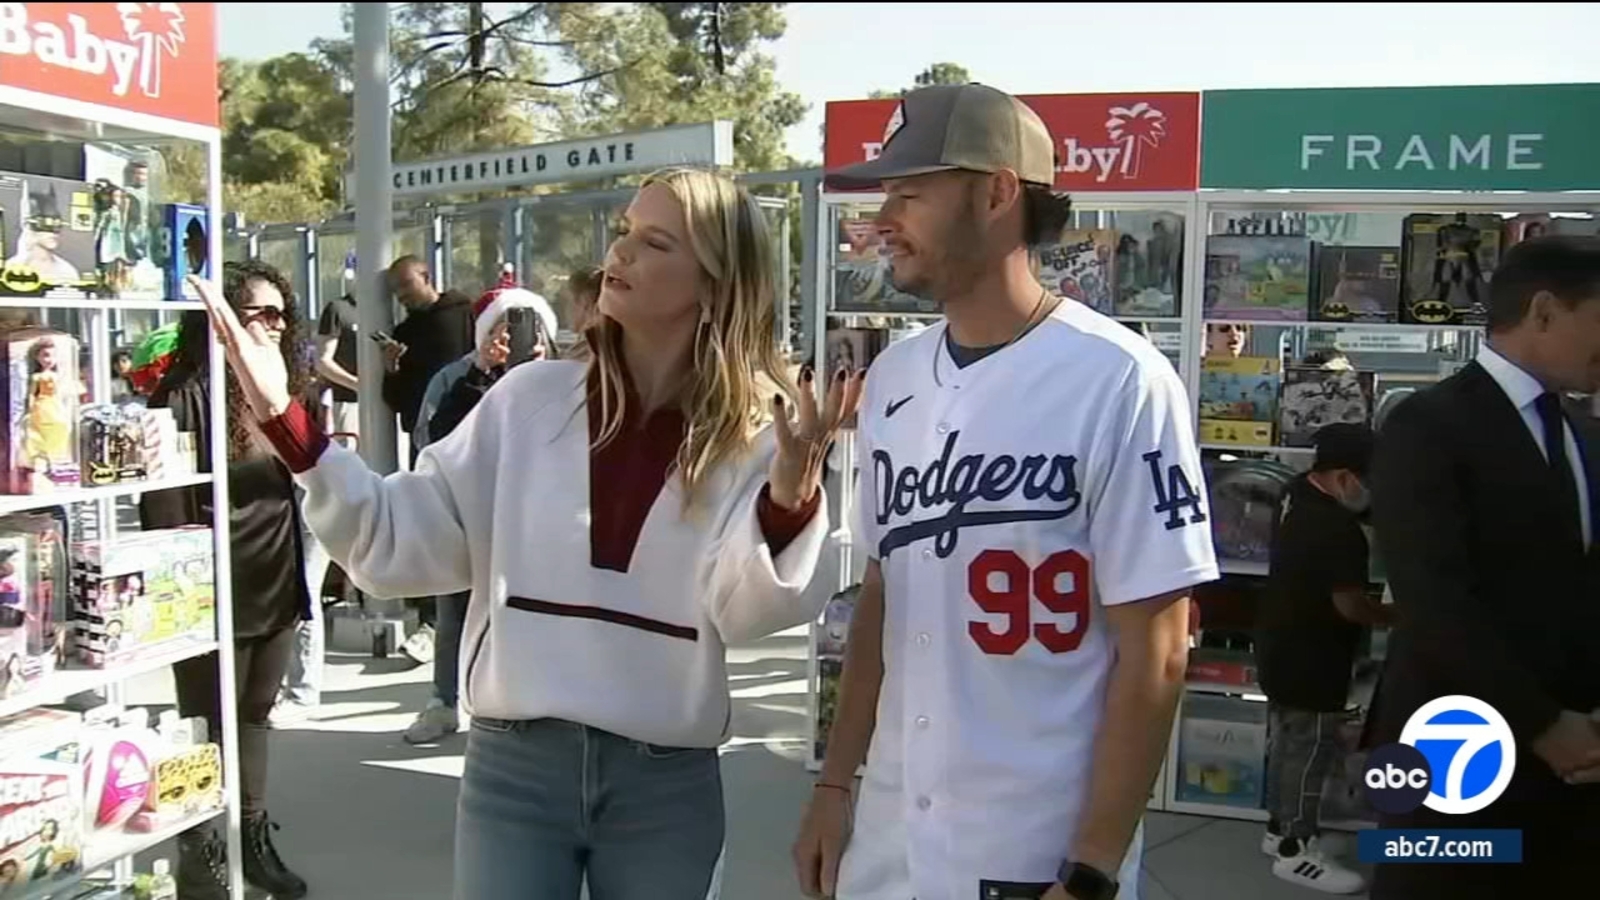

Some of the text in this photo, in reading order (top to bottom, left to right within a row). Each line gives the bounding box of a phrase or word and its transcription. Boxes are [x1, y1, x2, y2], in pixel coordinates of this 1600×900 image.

[393, 143, 635, 189] CENTERFIELD GATE
[1301, 133, 1544, 170] FRAME
[873, 430, 1081, 558] Dodgers
[1143, 450, 1206, 531] LA
[968, 549, 1090, 656] 99
